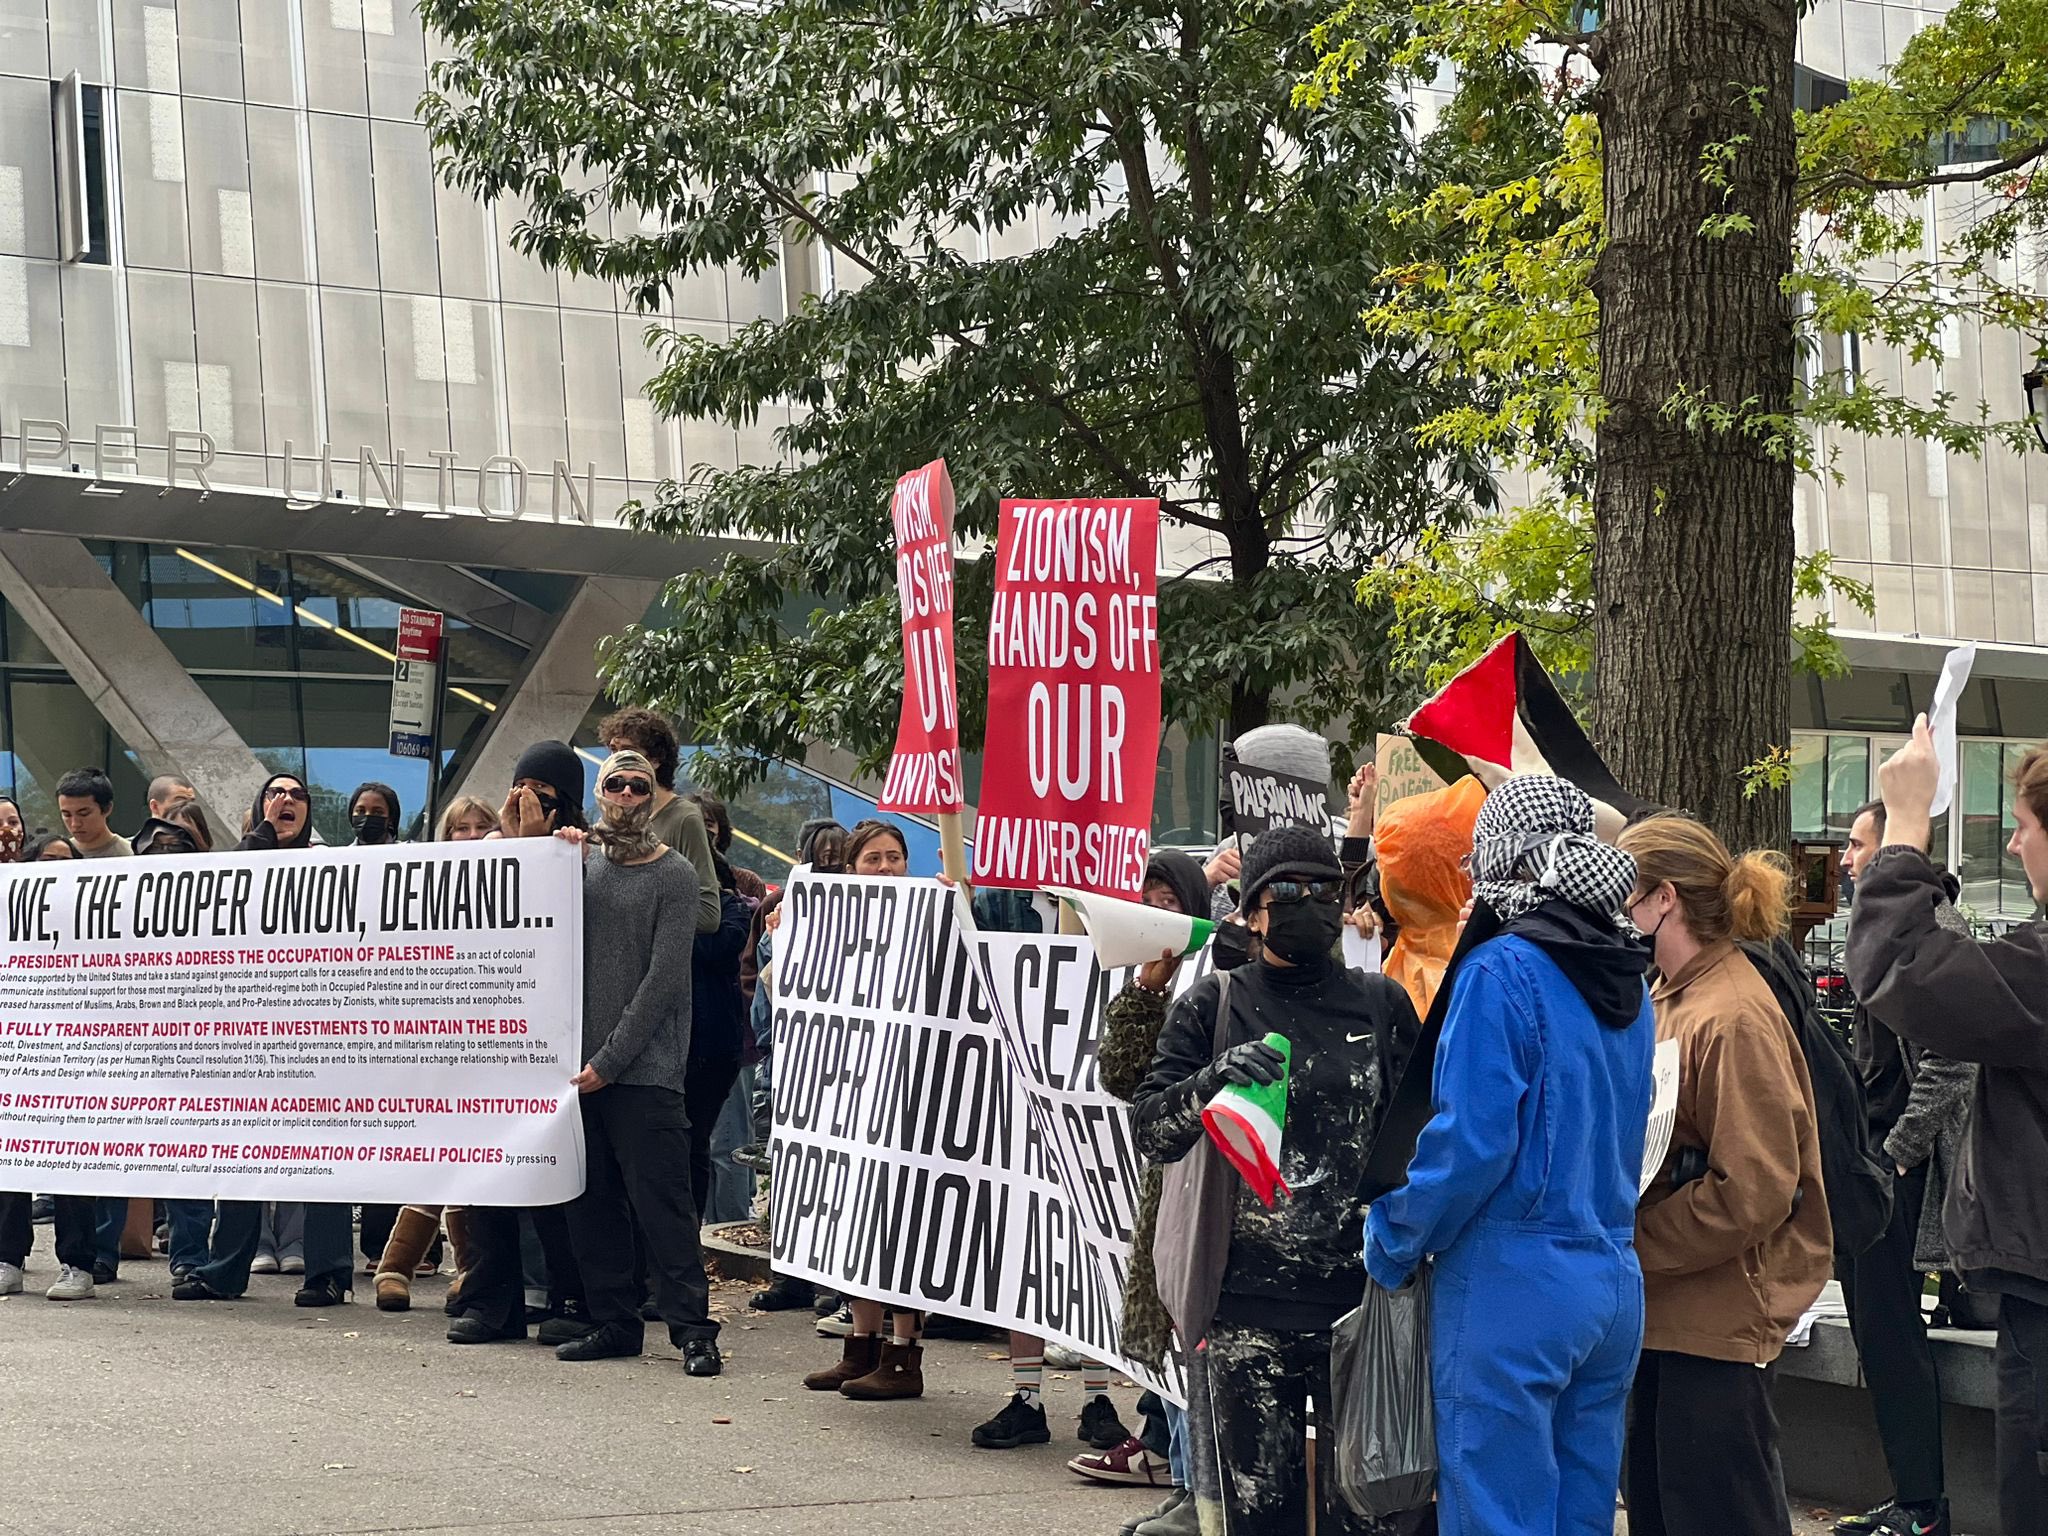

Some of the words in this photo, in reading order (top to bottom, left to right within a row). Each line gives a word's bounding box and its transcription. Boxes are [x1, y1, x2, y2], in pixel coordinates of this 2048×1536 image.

[284, 439, 597, 527] UNION
[1007, 506, 1141, 591] ZIONISM,
[926, 541, 951, 614] OFF
[401, 627, 423, 638] Anytime
[402, 614, 410, 624] NO
[410, 615, 436, 627] STANDING
[989, 592, 1098, 670] HANDS
[1109, 593, 1157, 673] OFF
[398, 661, 407, 680] 2
[910, 627, 955, 733] UR
[396, 741, 421, 756] 106069
[1027, 681, 1126, 804] OUR
[1388, 747, 1421, 776] FREE
[973, 815, 1148, 893] UNIVERSITIES
[8, 876, 59, 950] WE,
[74, 873, 129, 940] THE
[132, 869, 253, 938] COOPER
[260, 864, 368, 943] UNION,
[380, 857, 554, 932] DEMAND...
[82, 954, 122, 967] LAURA
[124, 952, 173, 966] SPARKS
[175, 951, 235, 965] ADDRESS
[237, 950, 264, 964] THE
[267, 948, 353, 963] OCCUPATION
[356, 947, 375, 961] OF
[378, 946, 455, 961] PALESTINE
[492, 950, 502, 959] of
[502, 949, 535, 959] colonial
[779, 881, 898, 1010] COOPER
[892, 886, 994, 1025] UNIO
[66, 974, 76, 984] by
[76, 973, 87, 981] the
[88, 973, 111, 981] United
[112, 972, 133, 981] States
[148, 972, 163, 980] take
[170, 971, 191, 979] stand
[191, 971, 218, 981] against
[219, 970, 253, 981] genocide
[254, 970, 268, 978] and
[269, 970, 299, 979] support
[299, 968, 318, 977] calls
[318, 968, 330, 977] for
[374, 968, 389, 976] and
[390, 967, 405, 975] end
[415, 967, 428, 975] the
[478, 965, 496, 974] This
[497, 965, 522, 974] would
[74, 1001, 83, 1009] of
[139, 1000, 161, 1008] Brown
[177, 999, 197, 1008] Black
[332, 998, 343, 1008] by
[378, 997, 400, 1005] white
[6, 1022, 53, 1036] FULLY
[55, 1023, 150, 1036] TRANSPARENT
[151, 1023, 191, 1036] AUDIT
[193, 1022, 211, 1036] OF
[214, 1022, 269, 1036] PRIVATE
[272, 1021, 368, 1035] INVESTMENTS
[370, 1020, 390, 1034] TO
[394, 1020, 463, 1034] MAINTAIN
[466, 1020, 496, 1034] THE
[499, 1019, 528, 1034] BDS
[773, 1007, 876, 1141] COOPER
[866, 1021, 1013, 1170] UNION
[14, 1094, 108, 1110] INSTITUTION
[110, 1097, 177, 1111] SUPPORT
[178, 1098, 268, 1111] PALESTINIAN
[270, 1098, 341, 1112] ACADEMIC
[344, 1098, 375, 1112] AND
[378, 1098, 453, 1113] CULTURAL
[457, 1099, 558, 1113] INSTITUTIONS
[66, 1115, 86, 1123] them
[96, 1117, 125, 1125] partner
[126, 1116, 143, 1124] with
[144, 1116, 169, 1125] Israeli
[242, 1118, 271, 1126] explicit
[282, 1118, 311, 1127] implicit
[350, 1118, 362, 1127] for
[5, 1139, 100, 1155] INSTITUTION
[103, 1143, 145, 1156] WORK
[148, 1144, 208, 1158] TOWARD
[211, 1145, 239, 1158] THE
[242, 1145, 355, 1160] CONDEMNATION
[357, 1147, 377, 1161] OF
[379, 1147, 435, 1162] ISRAELI
[438, 1148, 503, 1162] POLICIES
[505, 1156, 515, 1165] by
[516, 1156, 557, 1165] pressing
[24, 1159, 35, 1167] be
[36, 1160, 71, 1169] adopted
[71, 1162, 82, 1171] by
[181, 1164, 212, 1172] cultural
[264, 1166, 279, 1174] and
[843, 1156, 1010, 1314] UNION
